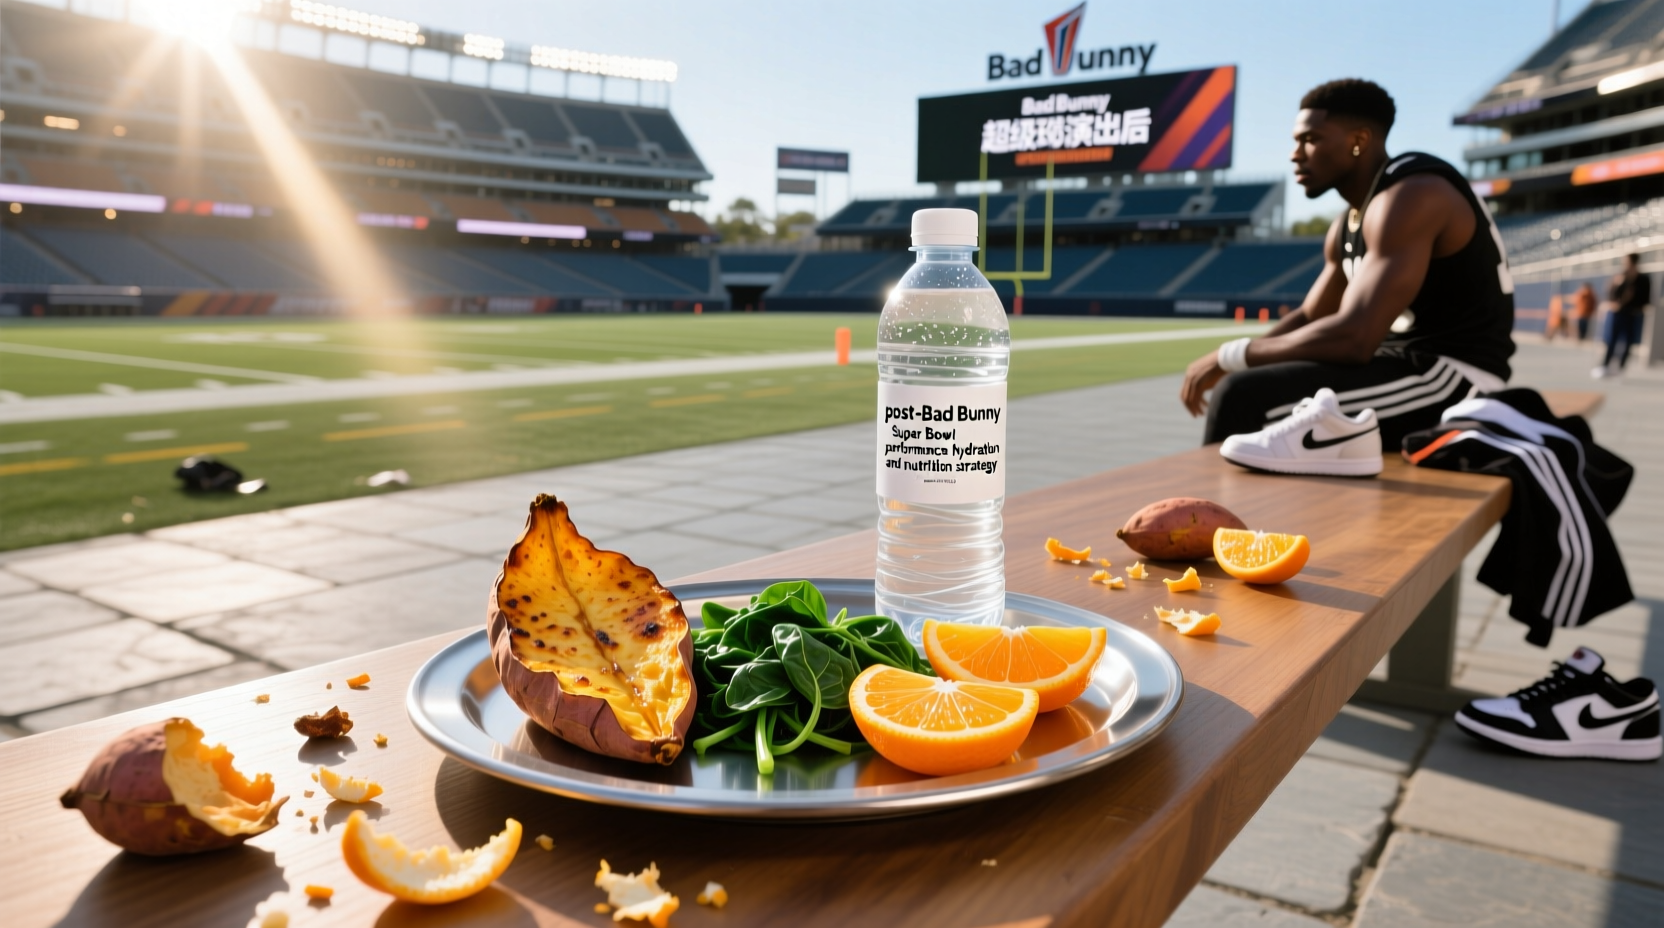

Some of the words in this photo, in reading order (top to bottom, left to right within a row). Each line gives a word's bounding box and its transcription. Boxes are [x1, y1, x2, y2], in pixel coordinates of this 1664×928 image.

[988, 49, 1041, 80] Bad
[1021, 94, 1055, 115] Bad
[1056, 93, 1111, 114] Bunny
[885, 405, 953, 423] post-Bad
[958, 405, 1000, 423] Bunny
[925, 427, 956, 440] Bowl
[885, 458, 901, 469] and
